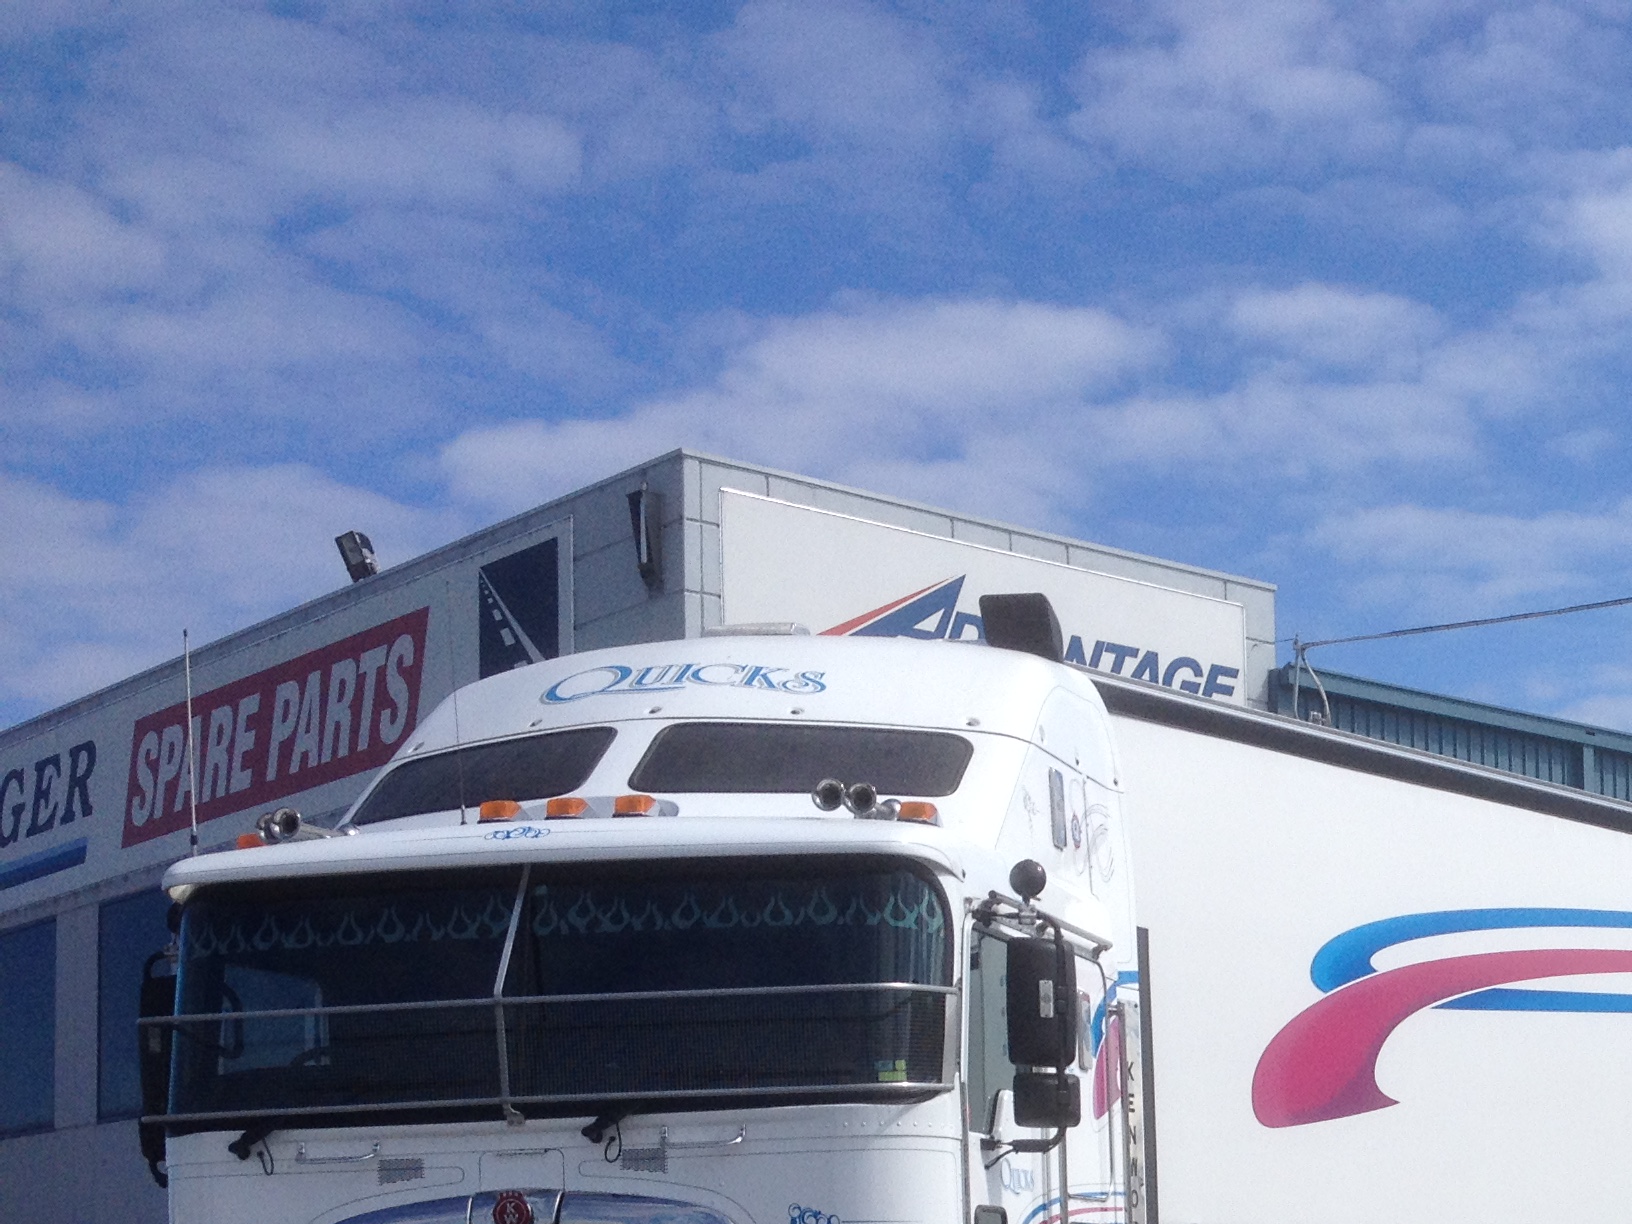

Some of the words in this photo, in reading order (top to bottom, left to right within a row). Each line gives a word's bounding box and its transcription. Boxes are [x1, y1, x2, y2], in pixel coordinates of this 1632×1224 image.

[131, 693, 261, 827] SPARE
[266, 634, 414, 782] PARTS
[539, 663, 827, 705] QUICKS
